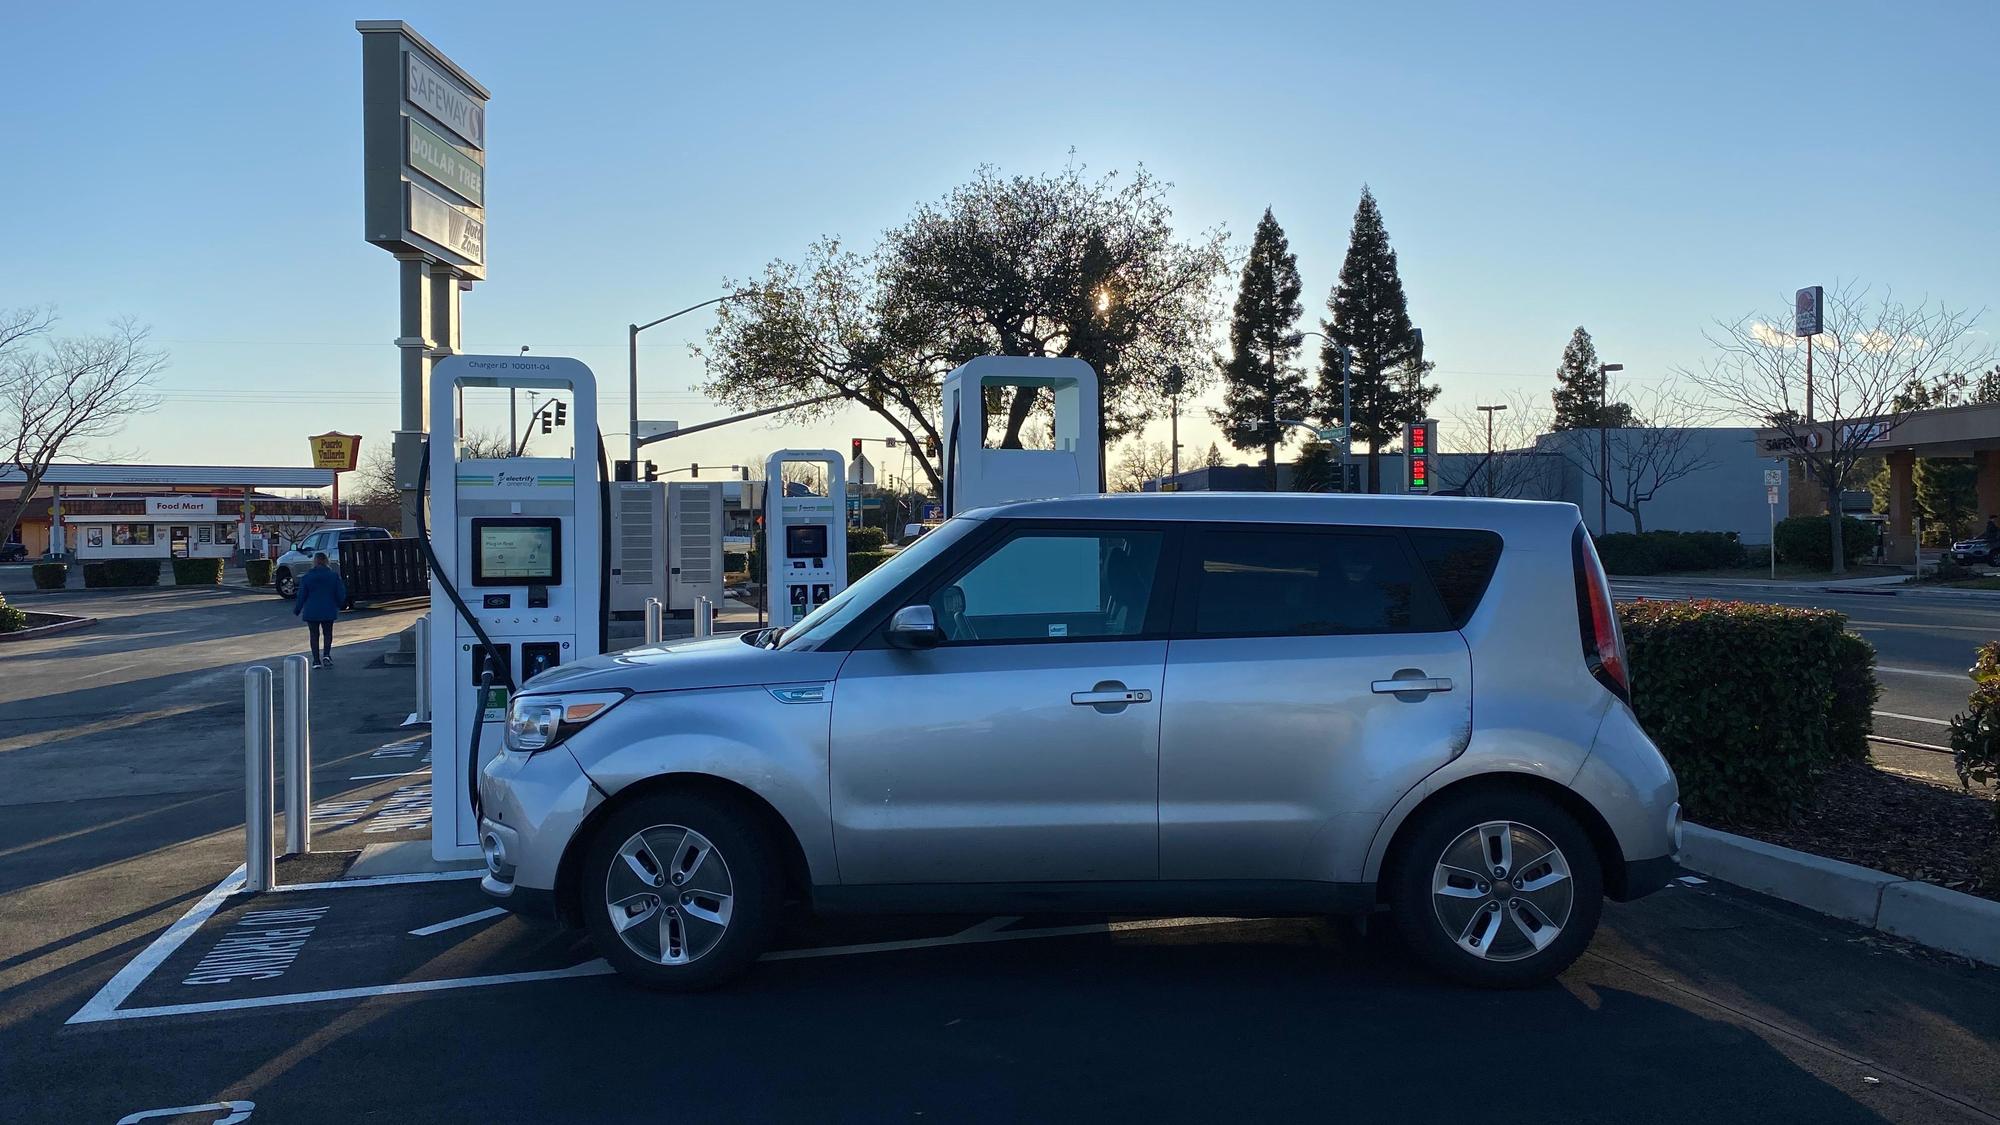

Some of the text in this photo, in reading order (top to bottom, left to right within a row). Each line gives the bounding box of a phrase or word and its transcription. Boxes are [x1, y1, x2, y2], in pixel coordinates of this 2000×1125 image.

[411, 66, 467, 126] SAFEWAY
[412, 134, 481, 193] DOLLAR TREE
[465, 219, 481, 239] Auto
[461, 233, 480, 256] Zone
[469, 361, 498, 369] Charger
[321, 439, 343, 448] Puerto
[506, 475, 535, 483] electrify
[157, 502, 204, 510] Food Mart
